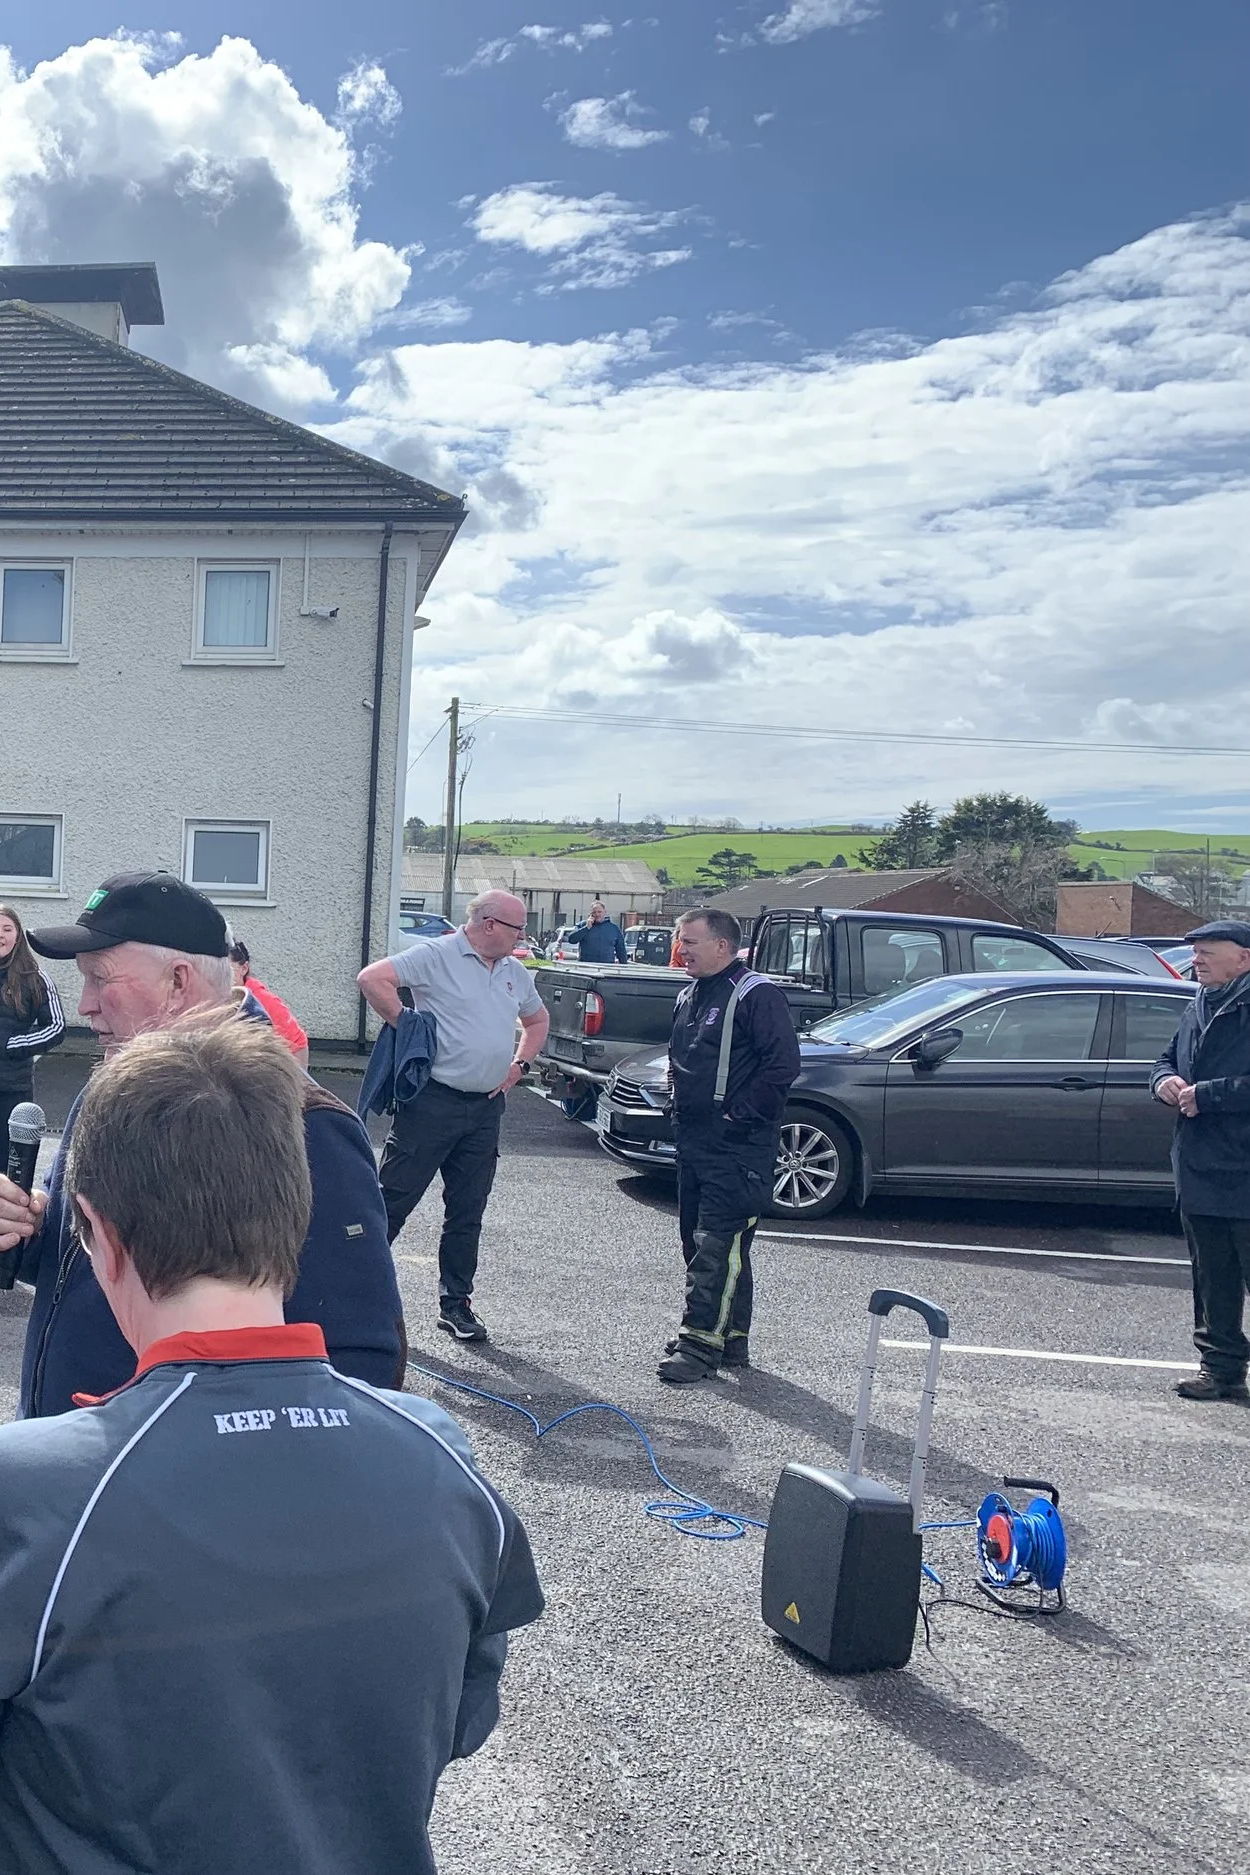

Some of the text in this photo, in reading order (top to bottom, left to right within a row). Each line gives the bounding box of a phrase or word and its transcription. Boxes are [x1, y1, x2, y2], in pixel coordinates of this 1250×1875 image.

[214, 1406, 350, 1434] KEEP 'ER LIT
